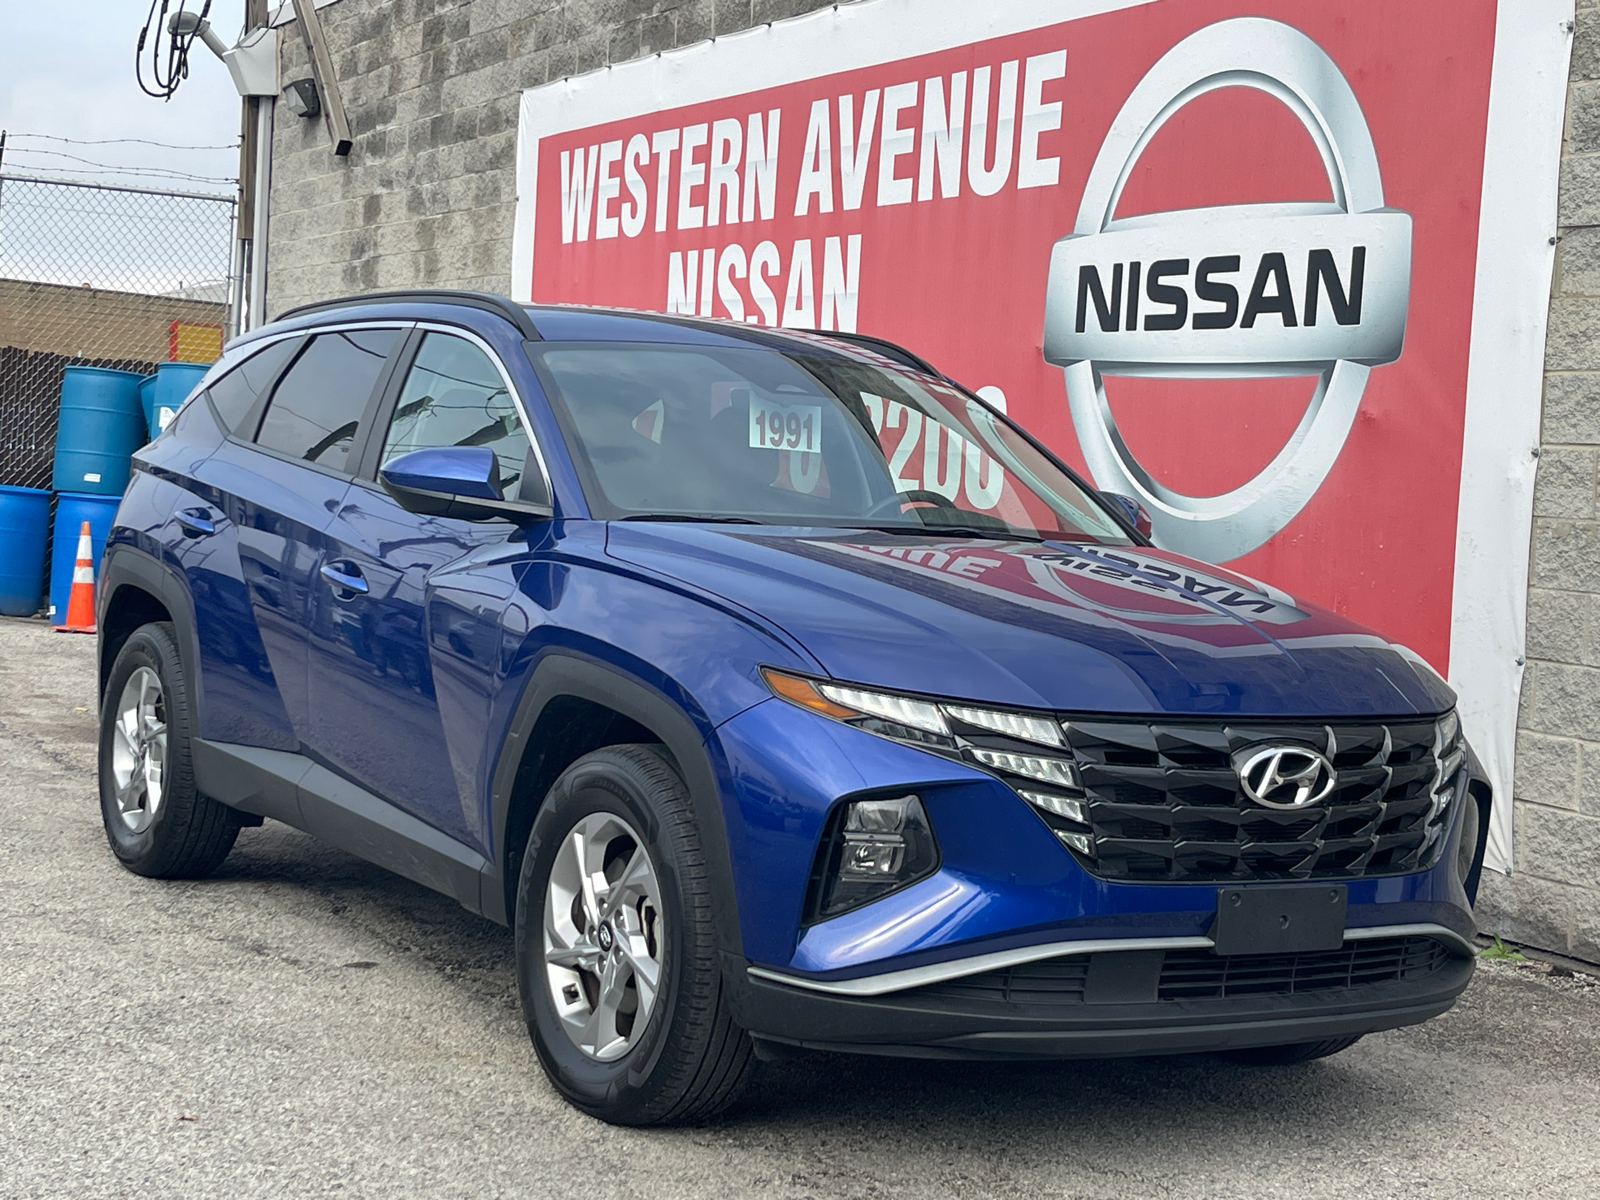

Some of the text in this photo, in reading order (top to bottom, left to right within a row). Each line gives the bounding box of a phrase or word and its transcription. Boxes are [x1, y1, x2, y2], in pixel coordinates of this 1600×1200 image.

[560, 49, 1068, 245] WESTERN AVENUE
[666, 234, 862, 330] NISSAN
[1075, 246, 1366, 333] NISSAN
[755, 409, 813, 450] 1991
